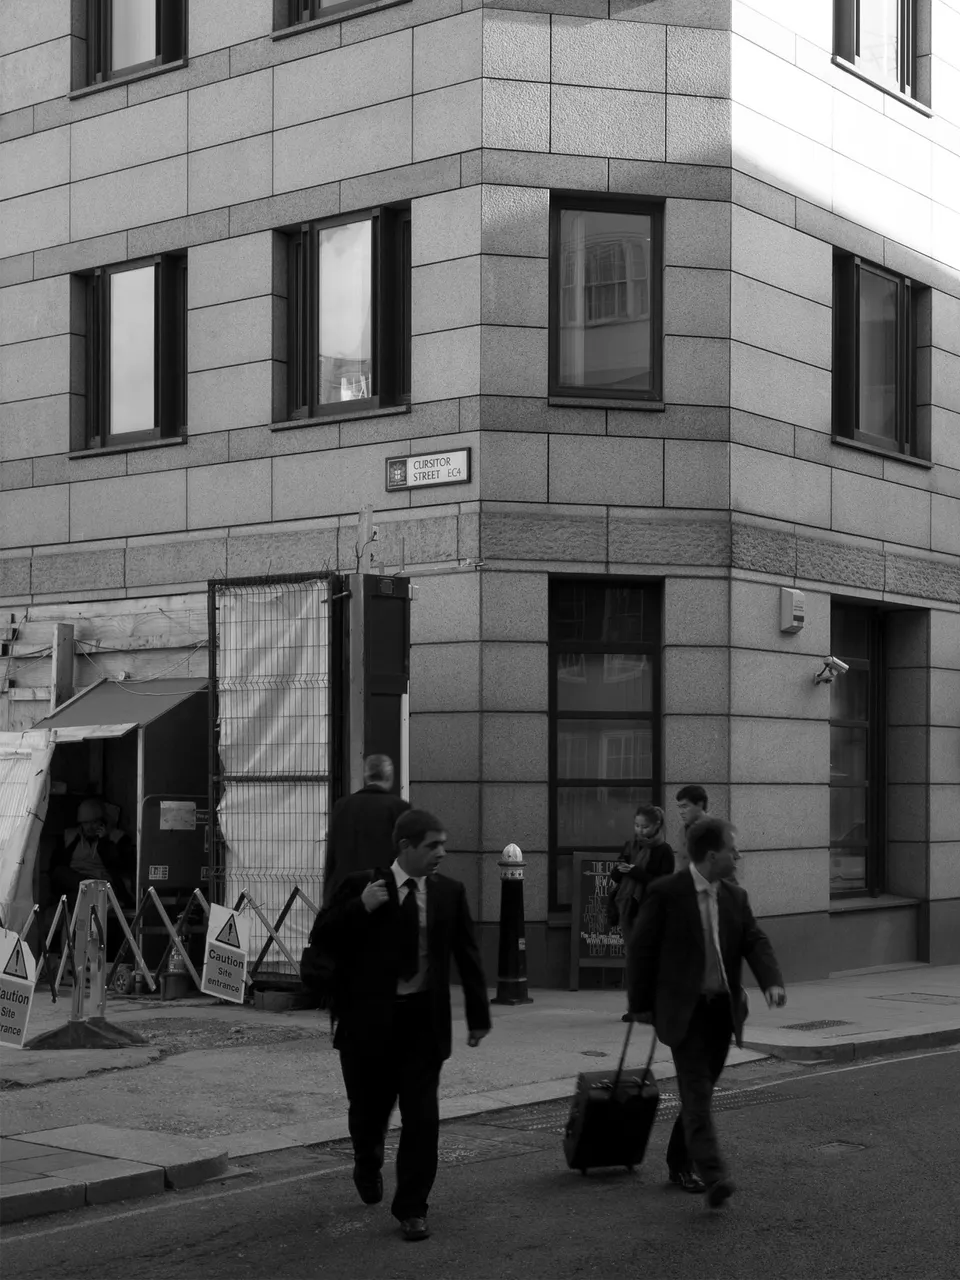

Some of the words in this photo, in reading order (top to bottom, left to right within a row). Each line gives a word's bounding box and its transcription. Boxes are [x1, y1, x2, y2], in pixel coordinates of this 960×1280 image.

[413, 457, 451, 470] CURSITOR
[413, 470, 441, 482] STREET
[447, 467, 462, 478] EC4
[209, 949, 244, 969] Caution
[218, 966, 232, 978] Site
[207, 977, 240, 993] entrance
[0, 988, 29, 1005] aution
[1, 1006, 15, 1019] Site
[0, 1024, 21, 1036] rance
